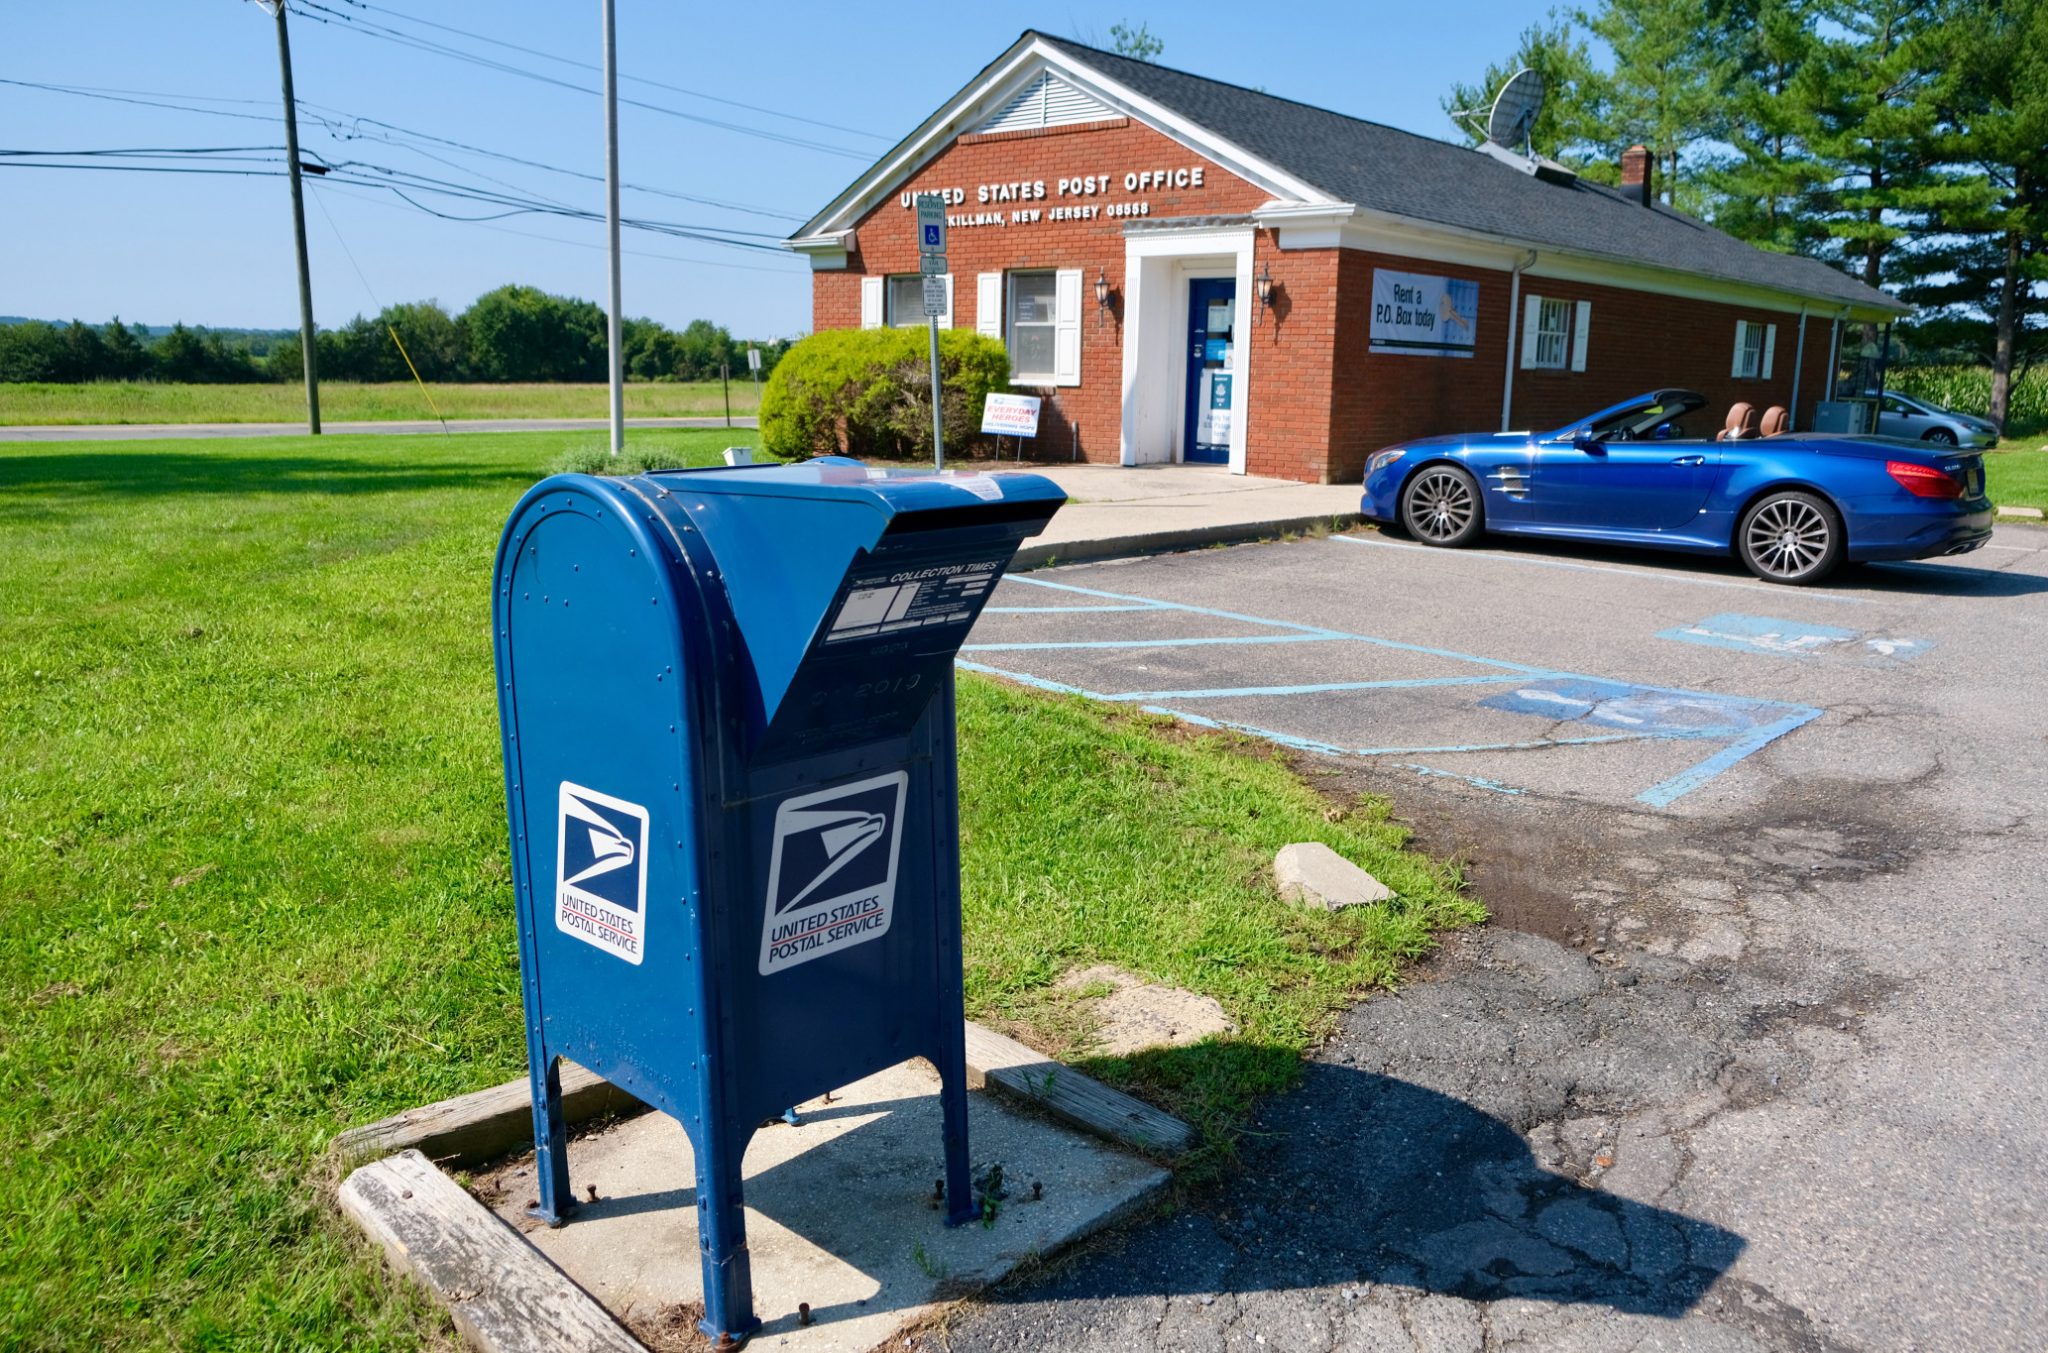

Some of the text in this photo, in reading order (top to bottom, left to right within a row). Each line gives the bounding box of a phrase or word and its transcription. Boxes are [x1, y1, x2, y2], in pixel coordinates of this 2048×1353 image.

[978, 181, 1045, 202] STATES
[1058, 175, 1110, 196] POST
[1124, 167, 1204, 191] OFFICE
[921, 210, 942, 220] PARKING
[945, 202, 1149, 227] KILLMAN, NEW JERSEY 08558
[1394, 283, 1422, 304] Rent a
[1376, 303, 1436, 332] P.O. Box today
[987, 405, 1037, 417] EVERYDAY
[991, 414, 1031, 424] HEROES
[890, 564, 965, 583] COLLECTION
[965, 561, 997, 573] TIMES
[562, 892, 634, 935] UNITED STATES
[771, 895, 880, 942] UNITED STATES
[561, 909, 638, 955] POSTAL SERVICE
[768, 912, 885, 963] POSTAL SERVICE
